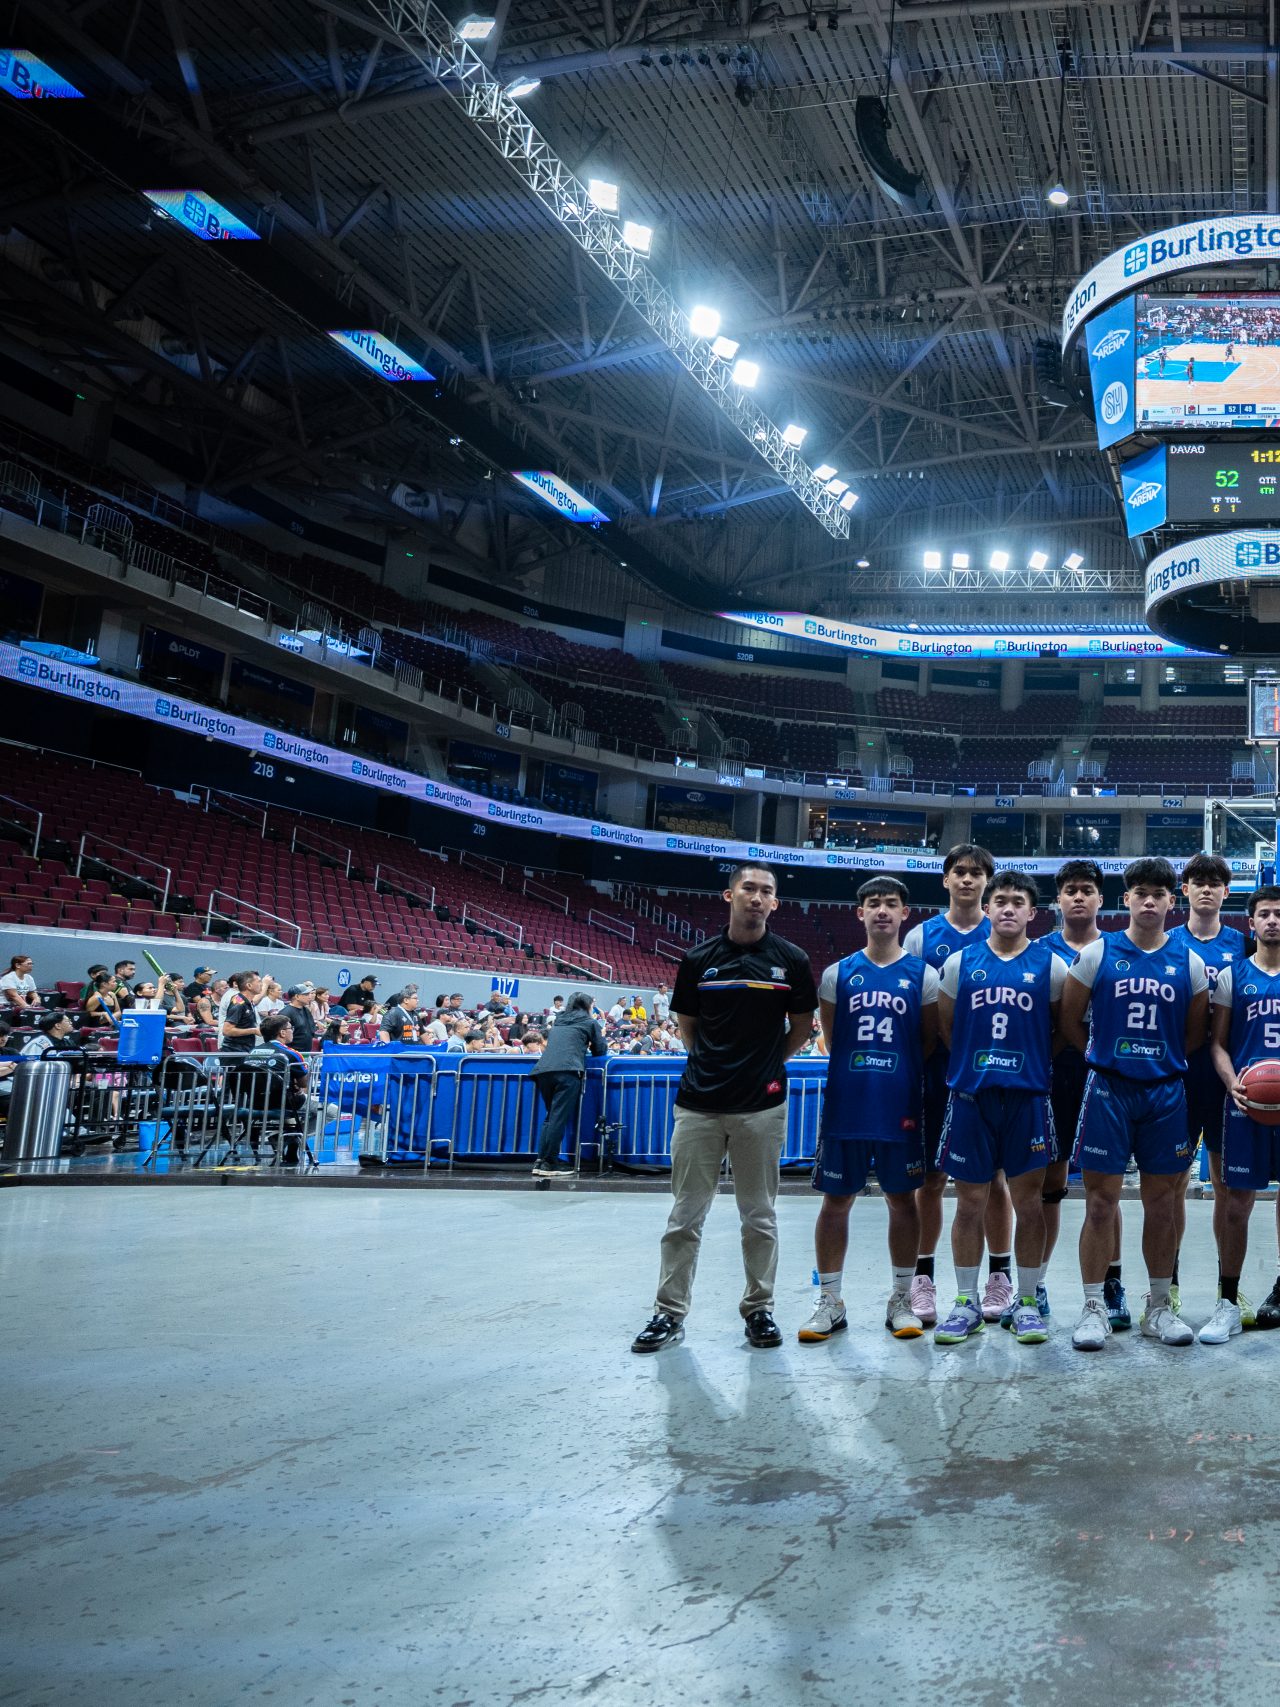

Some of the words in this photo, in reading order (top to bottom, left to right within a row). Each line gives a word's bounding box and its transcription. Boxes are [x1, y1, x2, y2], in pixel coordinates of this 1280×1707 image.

[1098, 337, 1125, 360] ARENA
[1105, 386, 1123, 419] SM
[1170, 445, 1205, 454] DAVAO
[1215, 471, 1239, 488] 52
[1132, 490, 1157, 507] ARENA
[818, 624, 877, 646] Burlington
[179, 644, 201, 659] PLDT
[912, 640, 972, 657] Burlington
[1007, 640, 1068, 655] Burlington
[1102, 640, 1163, 655] Burlington
[38, 663, 120, 700] Burlington
[171, 704, 236, 736] Burlington
[277, 738, 329, 764] Burlington
[253, 762, 273, 777] 218
[362, 765, 406, 789] Burlington
[434, 787, 472, 809] Burlington
[495, 806, 542, 826] Burlington
[473, 823, 486, 836] 219
[601, 826, 643, 844] Burlington
[677, 839, 726, 854] Burlington
[758, 847, 804, 862] Burlington
[837, 854, 884, 868] Burlington
[916, 859, 943, 868] Burlin
[993, 861, 1038, 872] Burlington
[1115, 977, 1175, 1002] EURO
[849, 991, 906, 1014] EURO
[971, 986, 1033, 1012] EURO
[1127, 1002, 1158, 1031] 21
[857, 1015, 893, 1042] 24
[992, 1012, 1008, 1039] 8
[1264, 1023, 1280, 1048] 5
[1132, 1043, 1160, 1056] Smart
[866, 1055, 892, 1068] Smart
[987, 1055, 1017, 1068] Smart
[1084, 1145, 1108, 1156] molten
[906, 1160, 922, 1169] PLAY
[1228, 1165, 1250, 1174] molten
